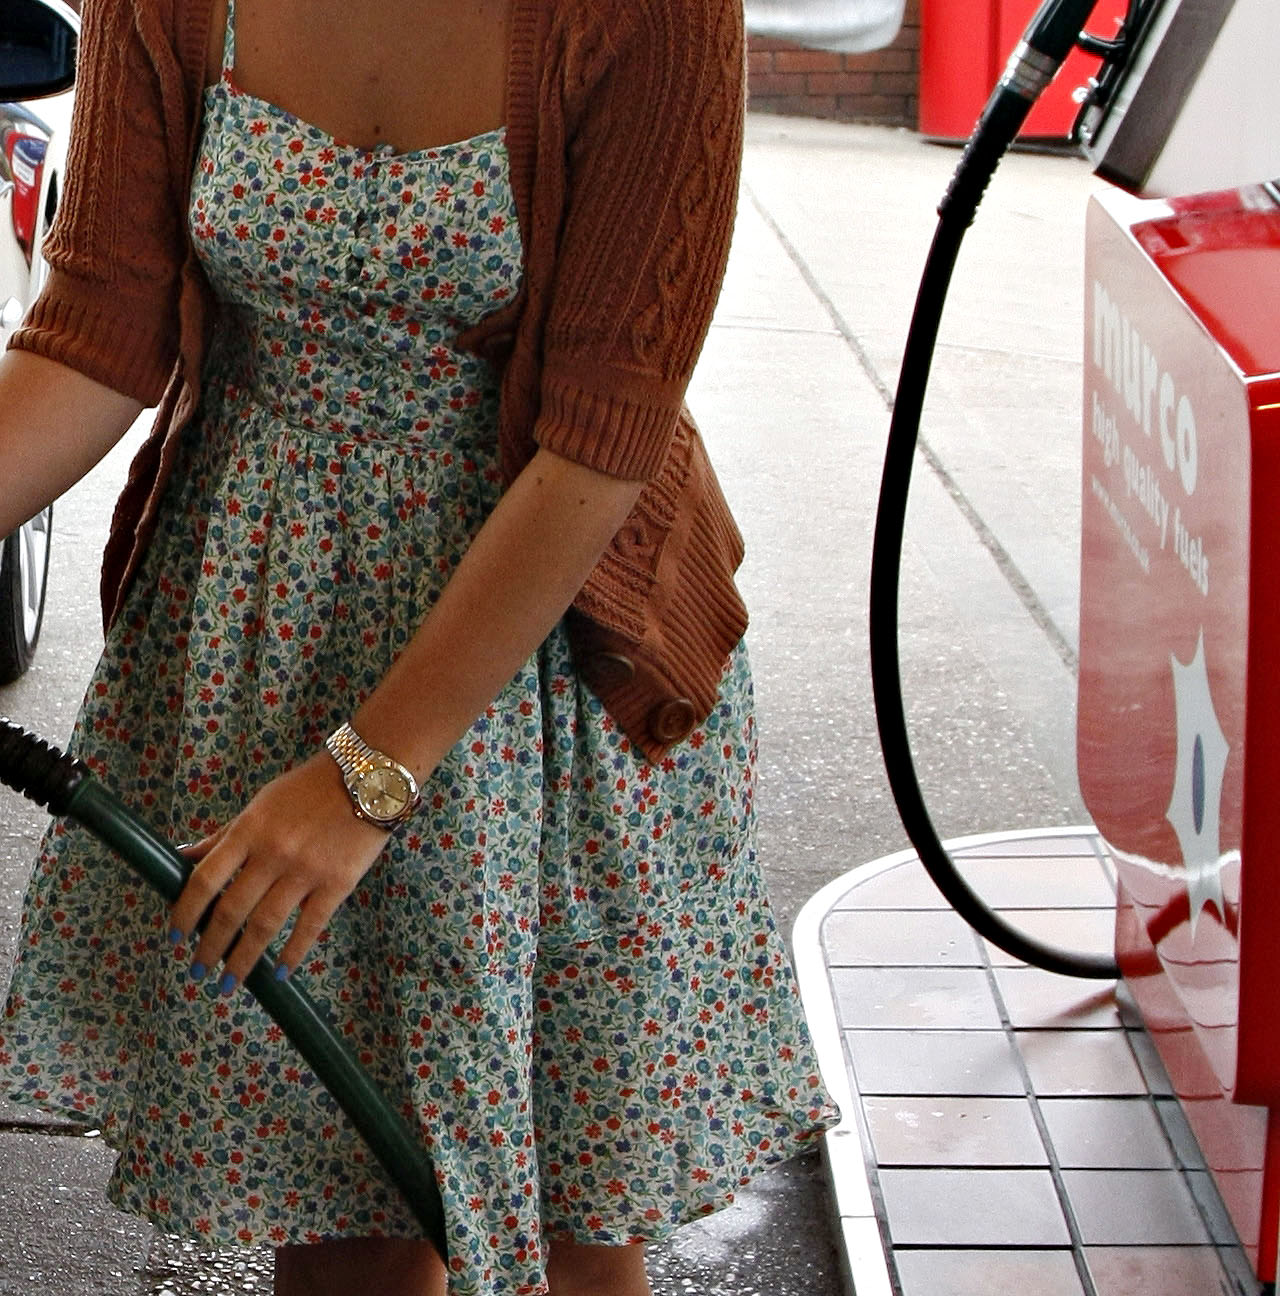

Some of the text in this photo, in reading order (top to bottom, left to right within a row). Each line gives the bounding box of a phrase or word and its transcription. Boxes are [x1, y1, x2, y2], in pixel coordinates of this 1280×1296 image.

[1093, 279, 1199, 497] murco
[1123, 444, 1170, 550] quality
[1173, 506, 1210, 597] fuels
